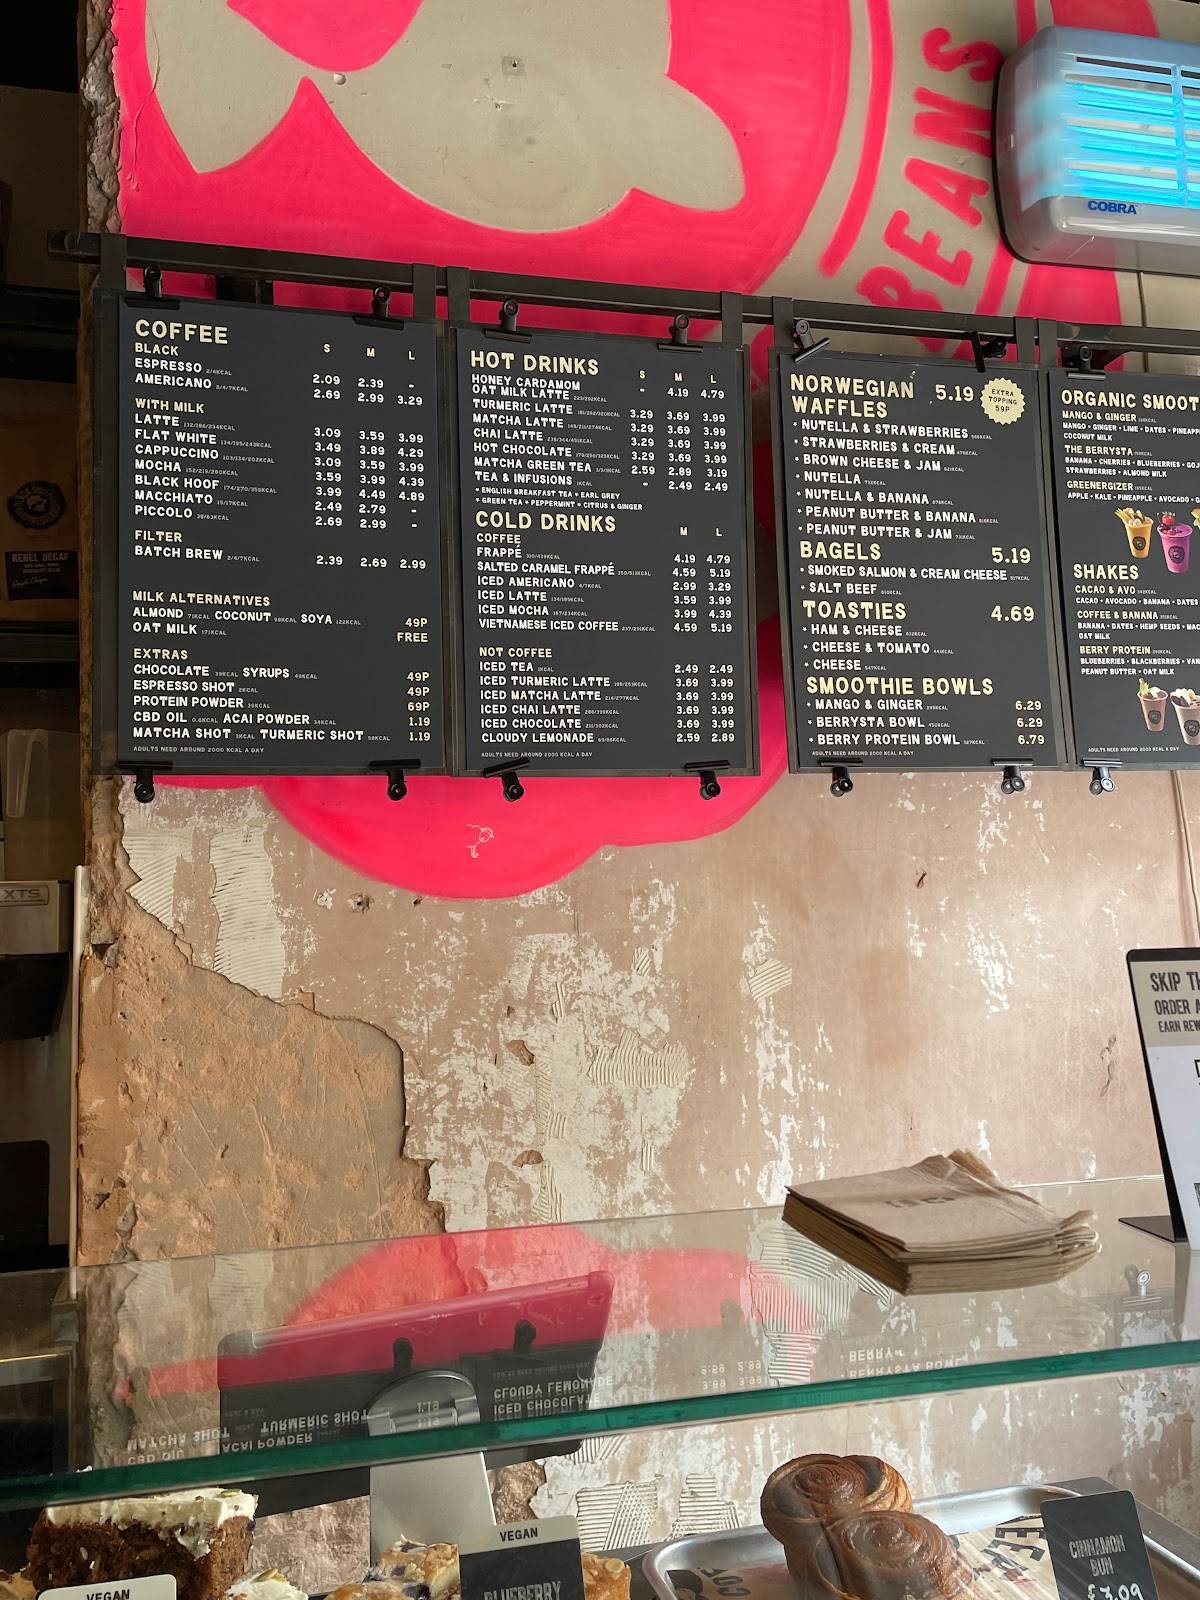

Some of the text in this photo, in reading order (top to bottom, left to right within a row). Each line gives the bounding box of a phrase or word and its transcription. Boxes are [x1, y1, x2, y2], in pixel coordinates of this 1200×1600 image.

[1087, 200, 1138, 215] COBRA
[136, 320, 227, 344] COFFEE
[135, 342, 178, 356] BLACK
[324, 344, 414, 360] S M L
[135, 358, 202, 372] ESPRESSO
[471, 350, 598, 375] HOT DRINKS
[472, 374, 580, 390] HONEY CARDAMOM
[640, 370, 716, 383] S M L
[136, 373, 211, 388] AMERICANO
[314, 389, 340, 399] 2.69
[358, 393, 384, 402] 2.99
[398, 396, 422, 405] 3.29
[472, 384, 569, 400] OAT MILK LATTE
[791, 374, 973, 401] NORWEGIAN 5.19
[136, 398, 204, 413] WITH MILK
[989, 396, 1017, 404] TOPPING
[1062, 390, 1136, 408] ORGANIC
[473, 398, 725, 422] TURMERIC LATTE 3.29 3.69 3.99
[792, 396, 887, 418] WAFFLES
[135, 414, 179, 426] LATTE
[1062, 410, 1093, 419] MANGO
[1105, 413, 1136, 422] GINGER
[802, 419, 858, 432] NUTELLA
[863, 424, 870, 433] &
[875, 424, 968, 438] STRAWBERRIES
[136, 429, 216, 444] FLAT WHITE
[136, 444, 218, 459] CAPPUCCINO
[1065, 445, 1082, 453] THE
[1086, 446, 1132, 456] BERRYSTA
[135, 459, 181, 472] MOCHA
[474, 456, 591, 472] MATCHA GREEN TEA
[804, 454, 848, 466] BROWN
[853, 457, 899, 469] CHEESE
[904, 460, 911, 469] &
[916, 460, 940, 471] JAM
[475, 471, 572, 485] TEA & INFUSIONS
[1066, 467, 1116, 475] STRAWBERRIES
[135, 474, 219, 489] BLACK HOOF
[1067, 481, 1133, 490] GREENERGIZER
[135, 490, 212, 504] MACCHIATO
[135, 505, 192, 518] PICCOLO
[476, 511, 615, 532] COLD DRINKS
[136, 530, 182, 542] FILTER
[477, 533, 520, 544] COFFEE
[135, 546, 222, 560] BATCH BREW
[477, 544, 522, 558] FRAPPÉ
[800, 541, 1030, 563] BAGELS 5.19
[478, 561, 614, 575] SALTED CARAMEL FRAPPÉ
[1074, 564, 1138, 580] SHAKES
[810, 582, 841, 593] SALT
[846, 584, 877, 594] BEEF
[1075, 585, 1105, 593] CACAO
[1109, 586, 1114, 594] &
[1118, 586, 1135, 594] AVO
[133, 591, 270, 606] MILK ALTERNATIVES
[215, 611, 332, 624] COCONUT SOYA
[803, 600, 1034, 621] TOASTIES 4.69
[479, 618, 618, 630] VIETNAMESE ICED COFFEE
[398, 632, 428, 642] FREE
[134, 648, 188, 659] EXTRAS
[480, 647, 552, 658] NOT COFFEE
[812, 642, 930, 653] CHEESE & TOMATO
[1080, 646, 1109, 654] BERRY
[1113, 646, 1150, 654] PROTEIN
[134, 664, 429, 681] CHOCOLATE SYRUPS 49P
[807, 676, 993, 695] SMOOTHIE BOWLS
[817, 716, 1042, 727] BERRYSTA BOWL 6.29
[260, 729, 430, 741] TURMERIC SHOT 1.19
[482, 733, 594, 742] CLOUDY LEMONADE
[1150, 971, 1181, 992] SKIP
[1154, 999, 1191, 1015] ORDER
[1158, 1021, 1182, 1032] EARN
[499, 1527, 538, 1542] VEGAN
[1069, 1534, 1126, 1559] CINNAMON
[1089, 1557, 1115, 1577] BUN
[86, 1589, 130, 1600] VEGAN
